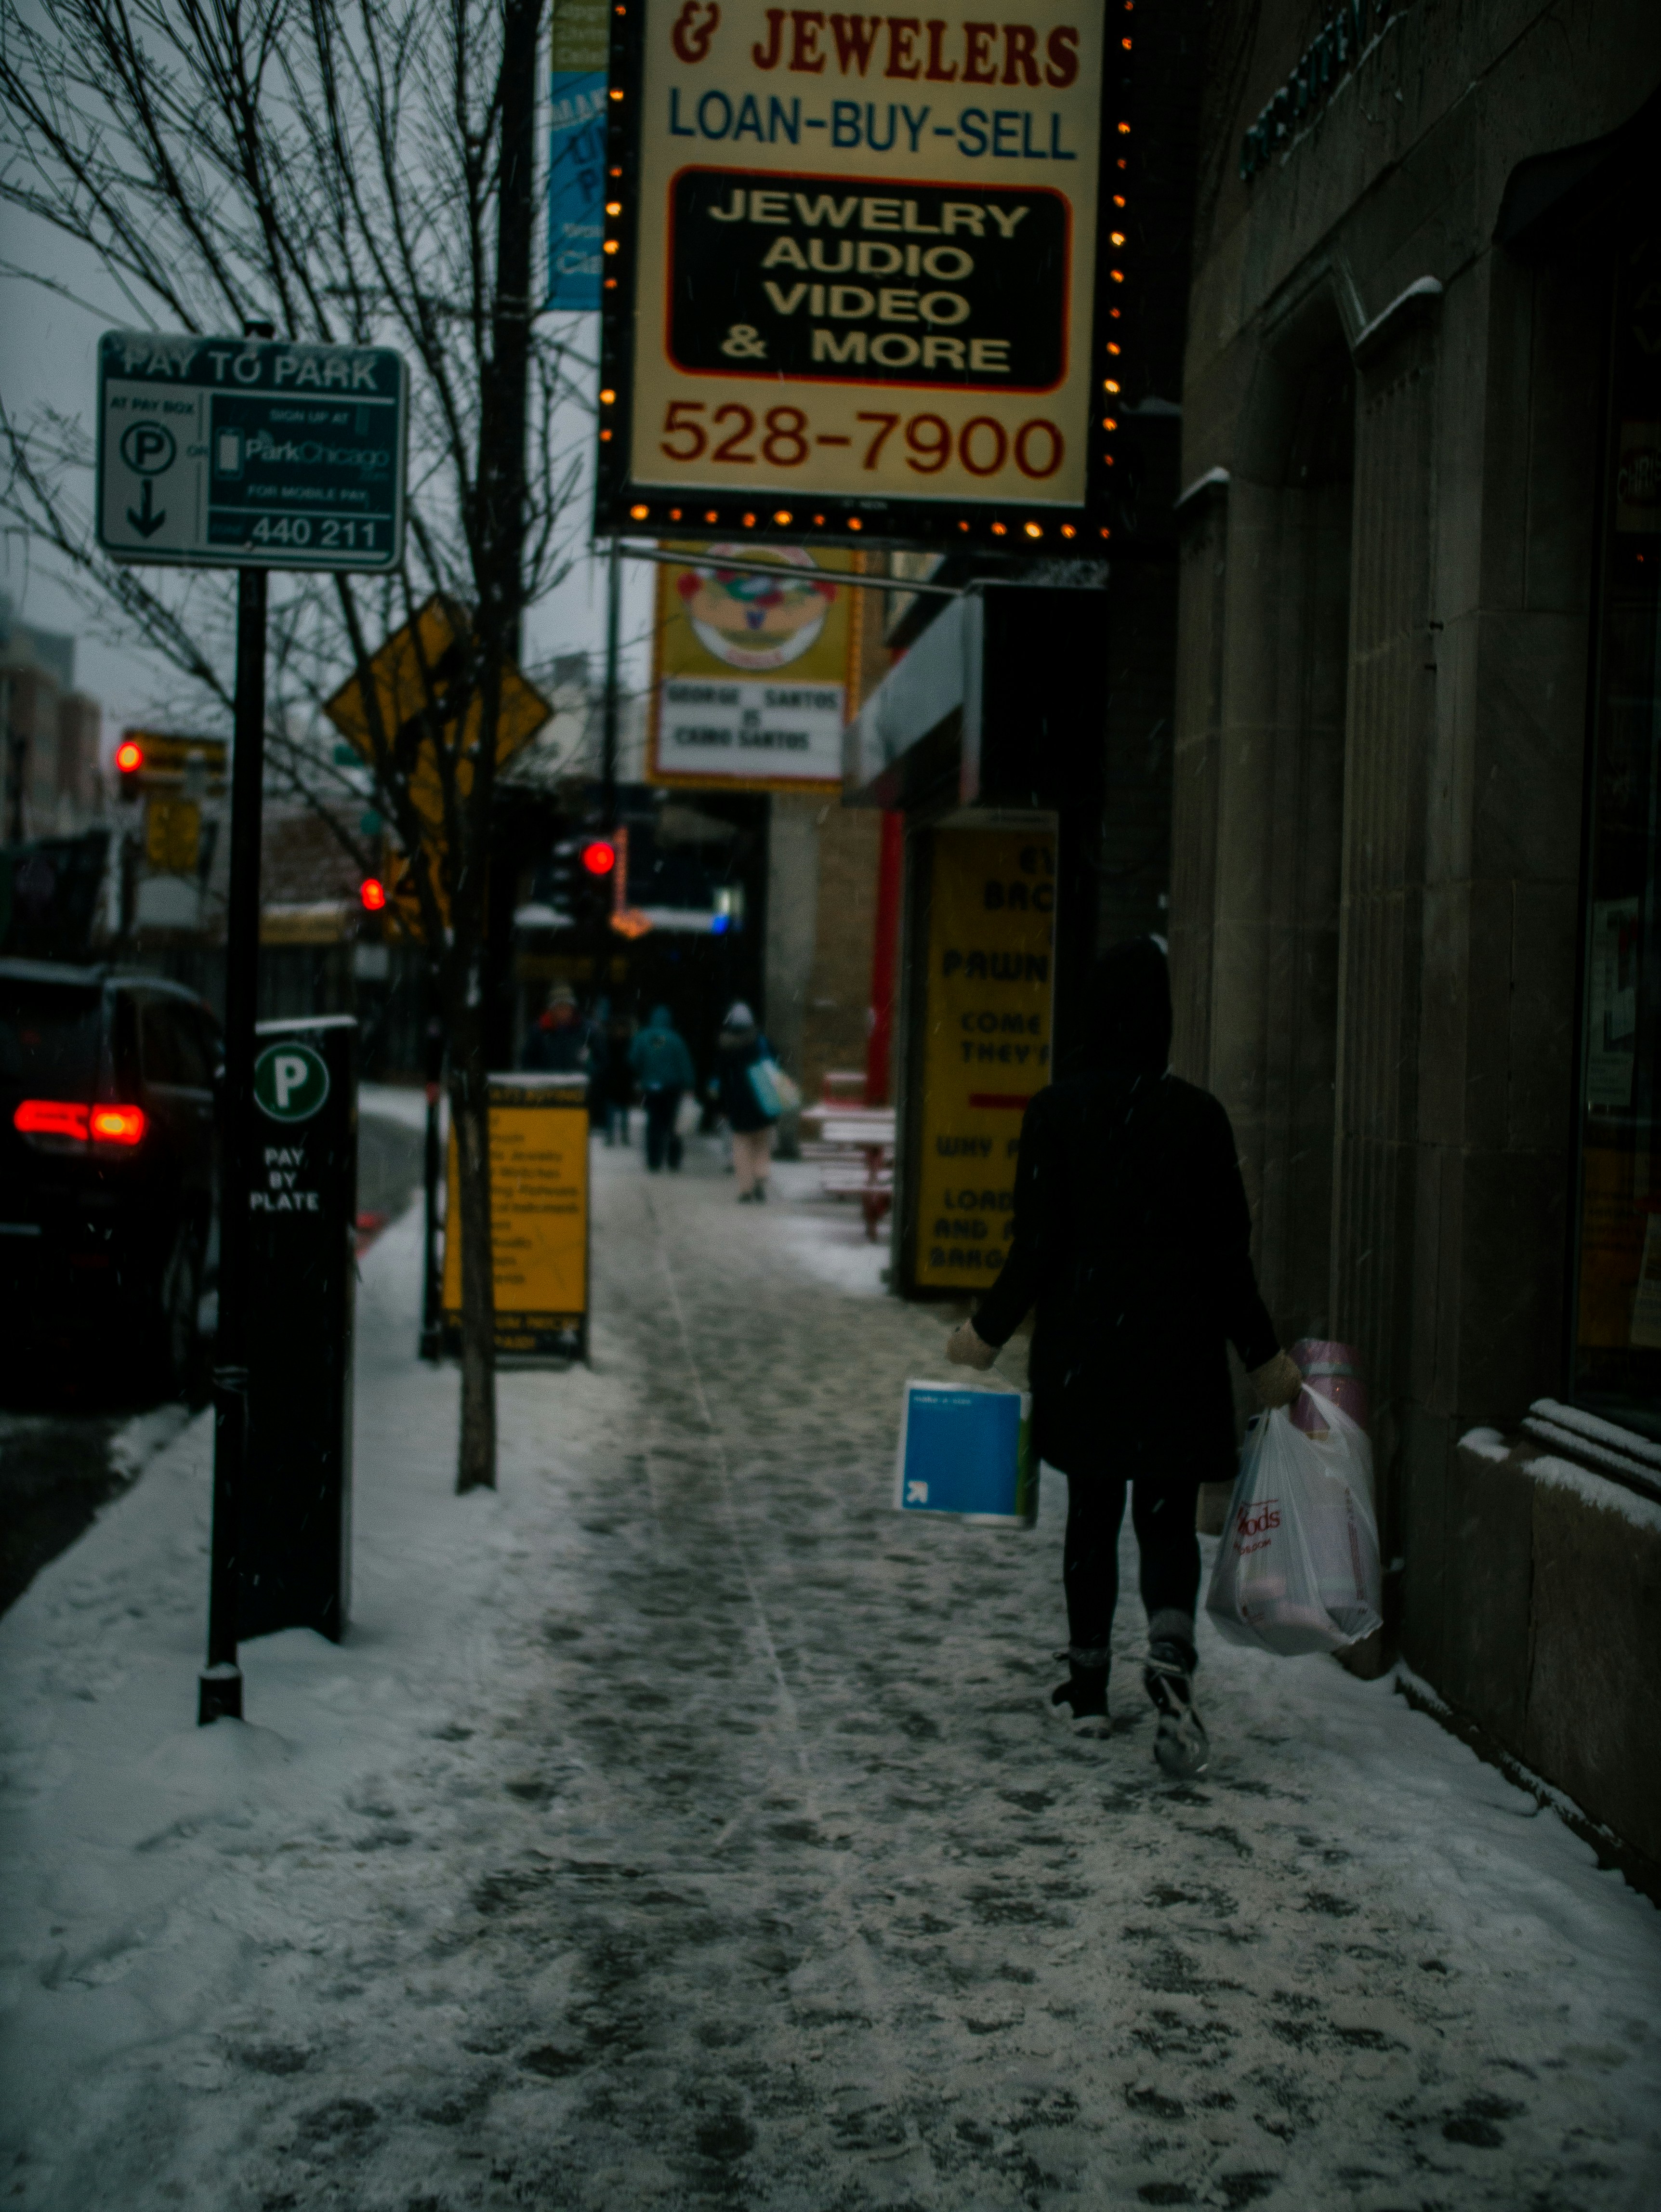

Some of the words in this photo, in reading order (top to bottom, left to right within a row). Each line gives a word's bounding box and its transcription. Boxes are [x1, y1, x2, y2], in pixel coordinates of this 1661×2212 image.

[672, 0, 719, 64] &
[753, 9, 1079, 87] JEWELERS
[669, 87, 1077, 161] LOAN-BUY-SELL
[707, 189, 1031, 238] JEWELRY
[760, 235, 974, 280] AUDIO
[761, 281, 971, 327] VIDEO
[720, 323, 768, 360] &
[811, 328, 1013, 373] MORE
[123, 350, 194, 378] PAY
[207, 351, 262, 384] TO
[273, 355, 378, 391] PARK
[110, 396, 128, 409] AT
[131, 397, 159, 411] PAY
[163, 401, 195, 415] BOX
[269, 408, 304, 423] SIGN
[307, 410, 329, 423] UP
[331, 410, 350, 424] AT
[135, 431, 164, 465] P
[660, 401, 1064, 478] 528-7900
[247, 485, 277, 499] FOR
[280, 486, 334, 500] MOBILE
[340, 488, 367, 501] PAY
[251, 517, 311, 544] 440
[320, 519, 376, 548] 211
[764, 688, 837, 709] SANTOS
[738, 730, 809, 750] SANTOS
[943, 949, 1048, 982] PAWN
[961, 1013, 1041, 1035] COME
[274, 1055, 309, 1108] P
[263, 1146, 305, 1167] PAY
[936, 1135, 993, 1157] WHY
[267, 1169, 298, 1190] BY
[249, 1190, 321, 1212] PLATE
[934, 1218, 988, 1240] AND
